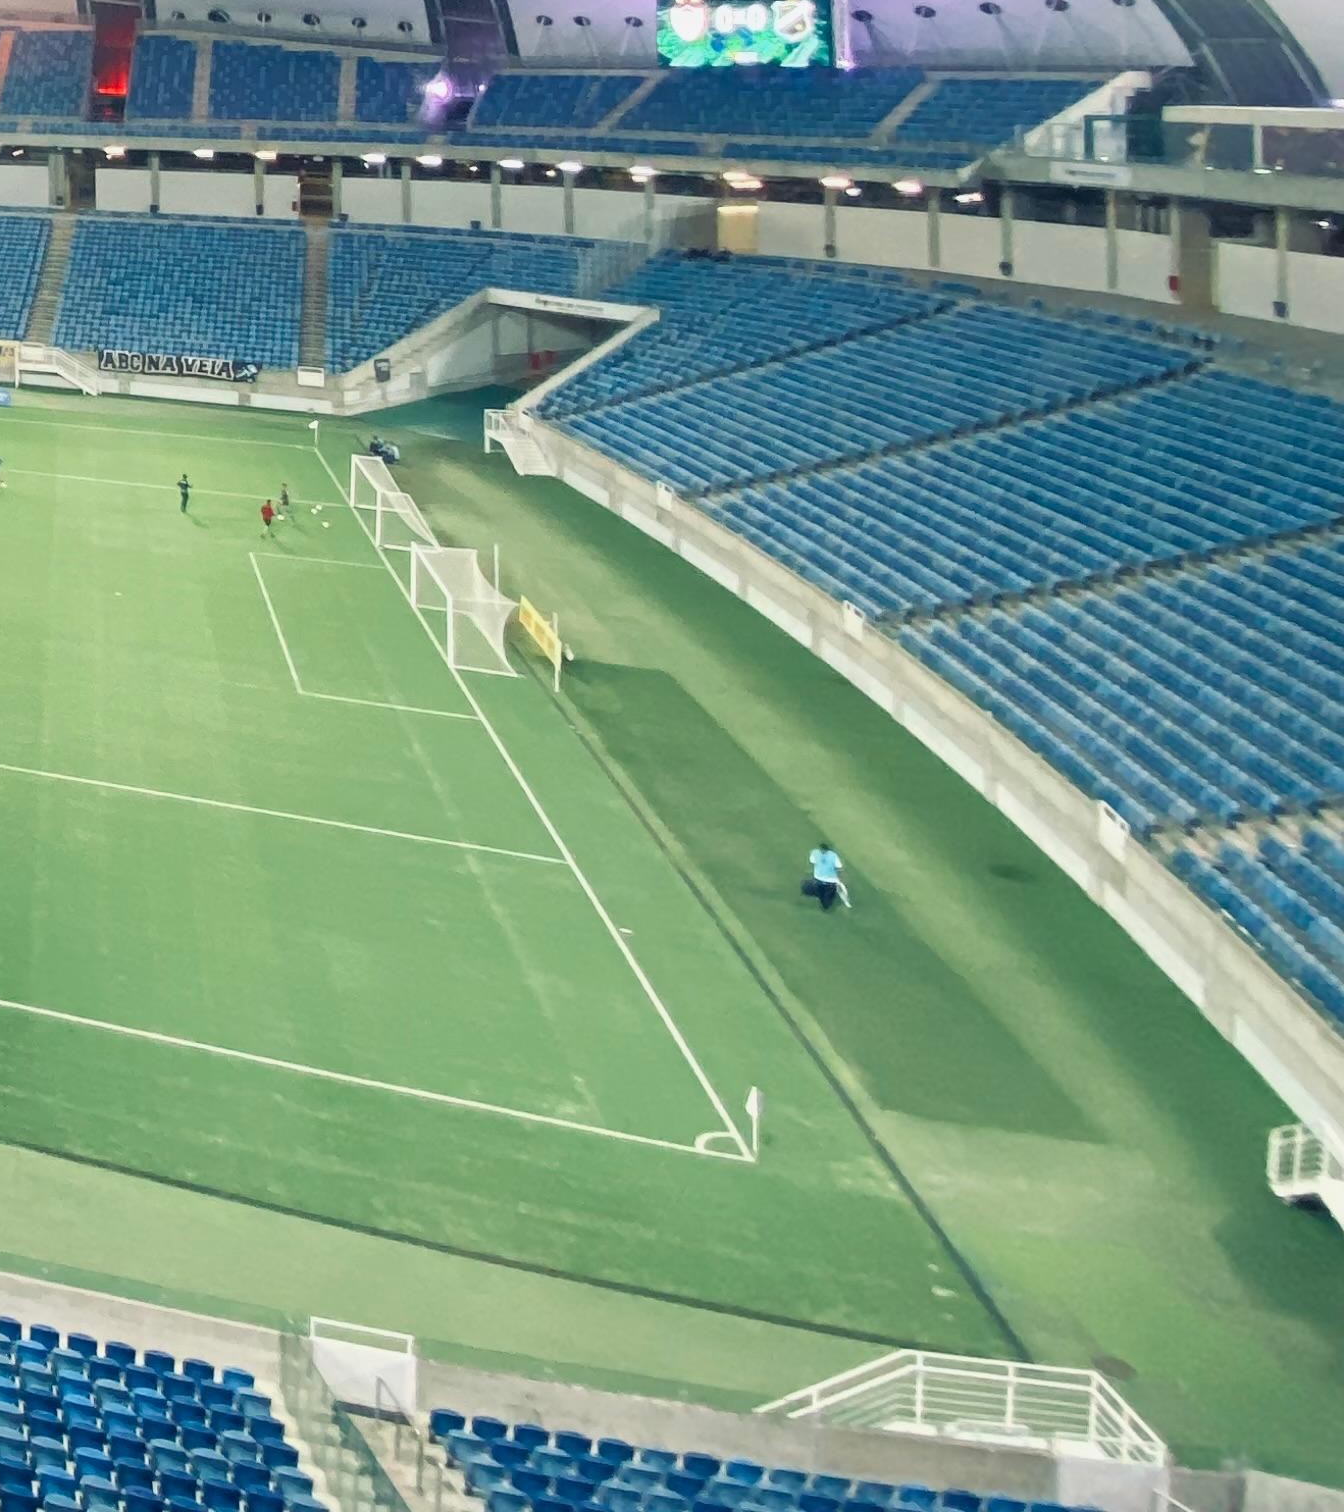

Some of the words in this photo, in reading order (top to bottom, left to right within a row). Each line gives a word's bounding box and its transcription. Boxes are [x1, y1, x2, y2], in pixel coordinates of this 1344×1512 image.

[101, 350, 143, 373] ABC
[144, 353, 178, 375] NA
[181, 356, 235, 381] VEIA
